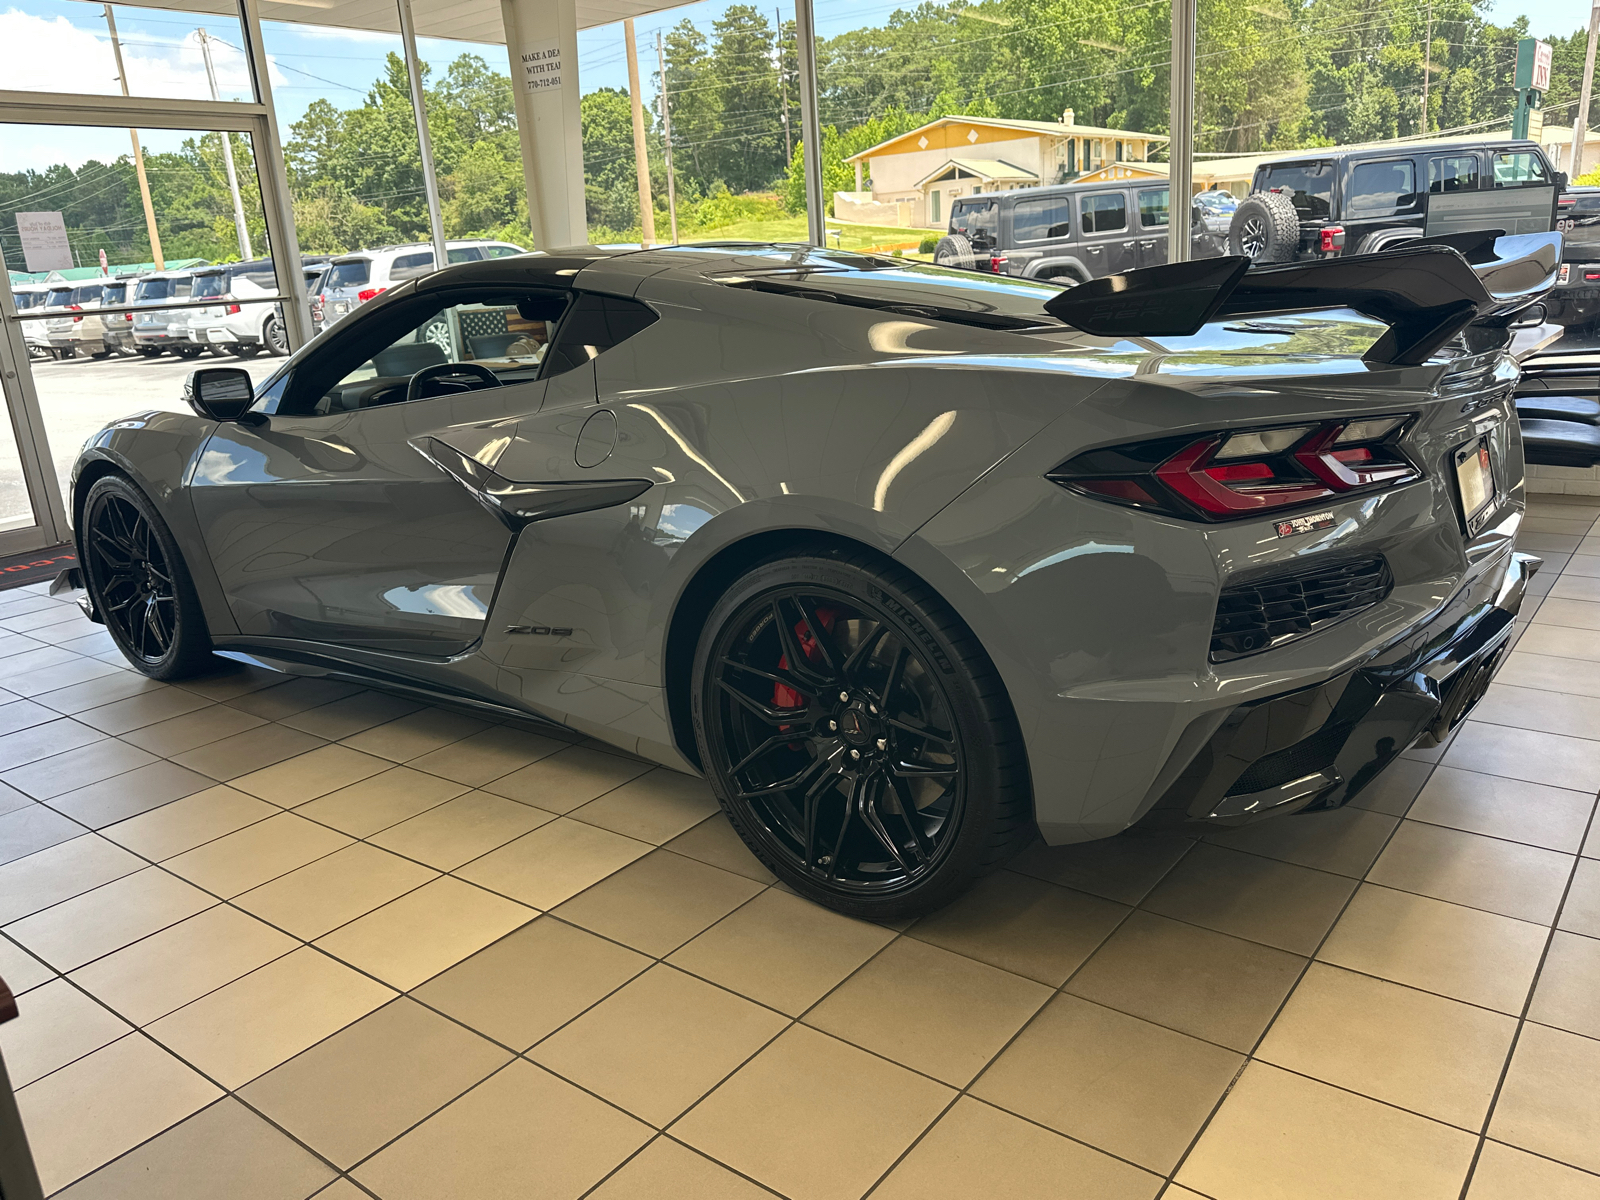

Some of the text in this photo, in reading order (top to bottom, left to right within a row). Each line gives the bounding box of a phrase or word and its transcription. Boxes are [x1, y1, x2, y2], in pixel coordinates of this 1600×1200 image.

[521, 51, 541, 63] MAKE
[541, 51, 547, 59] A
[526, 64, 545, 75] WITH
[503, 624, 573, 636] Z06
[749, 612, 774, 641] FORGED
[884, 598, 953, 671] MICHELIN
